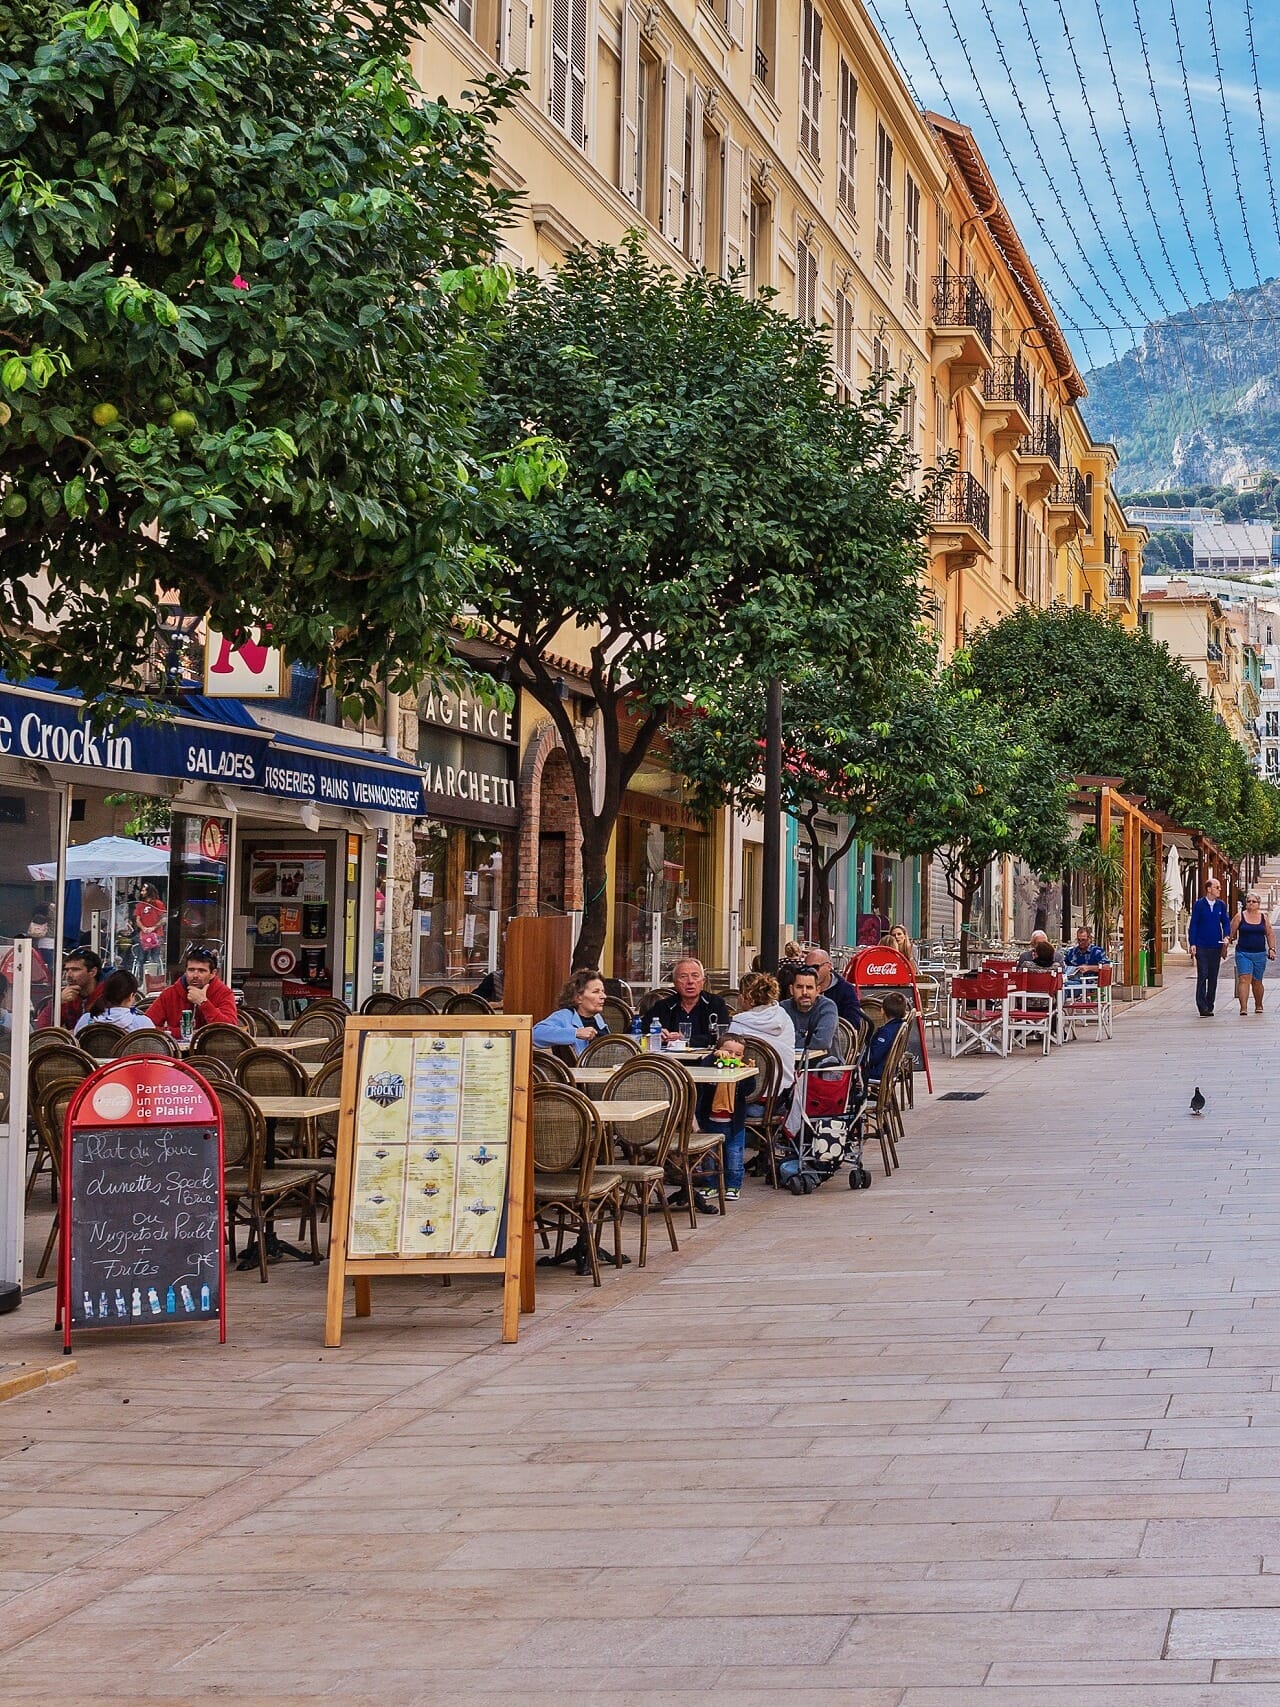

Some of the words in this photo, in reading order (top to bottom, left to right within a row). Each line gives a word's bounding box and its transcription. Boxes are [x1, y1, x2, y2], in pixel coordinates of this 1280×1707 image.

[425, 690, 513, 741] AGENCE
[20, 712, 133, 771] Crock'in
[186, 746, 255, 780] SALADES
[320, 775, 349, 800] PAINS
[352, 781, 420, 810] VIENNOISERIES
[419, 760, 516, 809] MARCHETTI
[136, 1083, 194, 1095] Partagez
[136, 1097, 151, 1106] un
[154, 1094, 202, 1106] moment
[365, 1083, 406, 1100] CROCK'IN
[137, 1107, 151, 1118] de
[155, 1105, 194, 1116] Plaisir
[129, 1139, 151, 1161] du
[173, 1212, 216, 1241] Poulet
